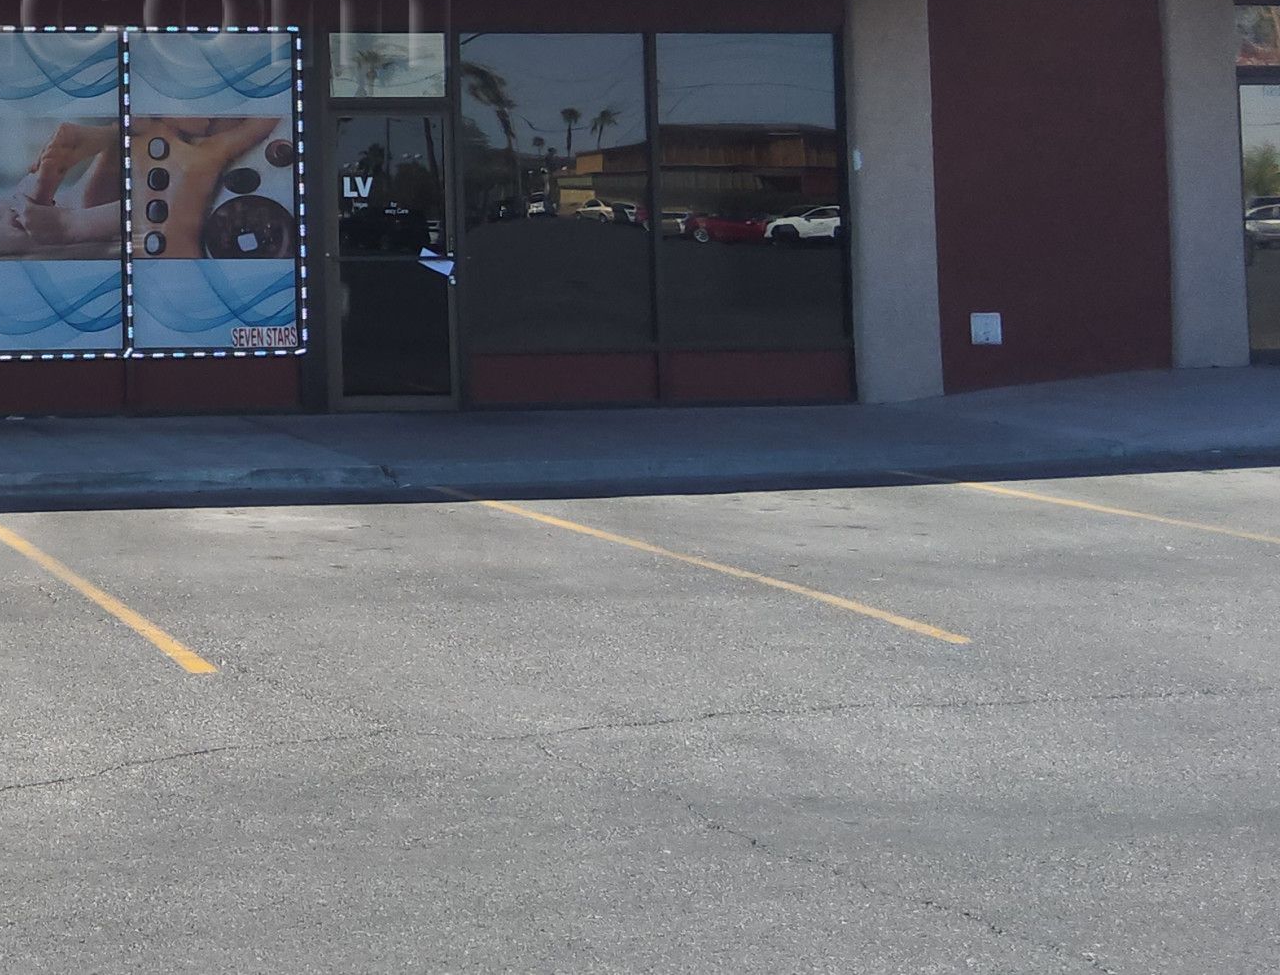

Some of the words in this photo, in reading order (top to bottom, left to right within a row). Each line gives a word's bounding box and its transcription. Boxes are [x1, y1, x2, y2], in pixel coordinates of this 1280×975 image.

[343, 176, 373, 197] LV
[232, 327, 264, 346] SEVEN
[266, 327, 297, 346] STARS
